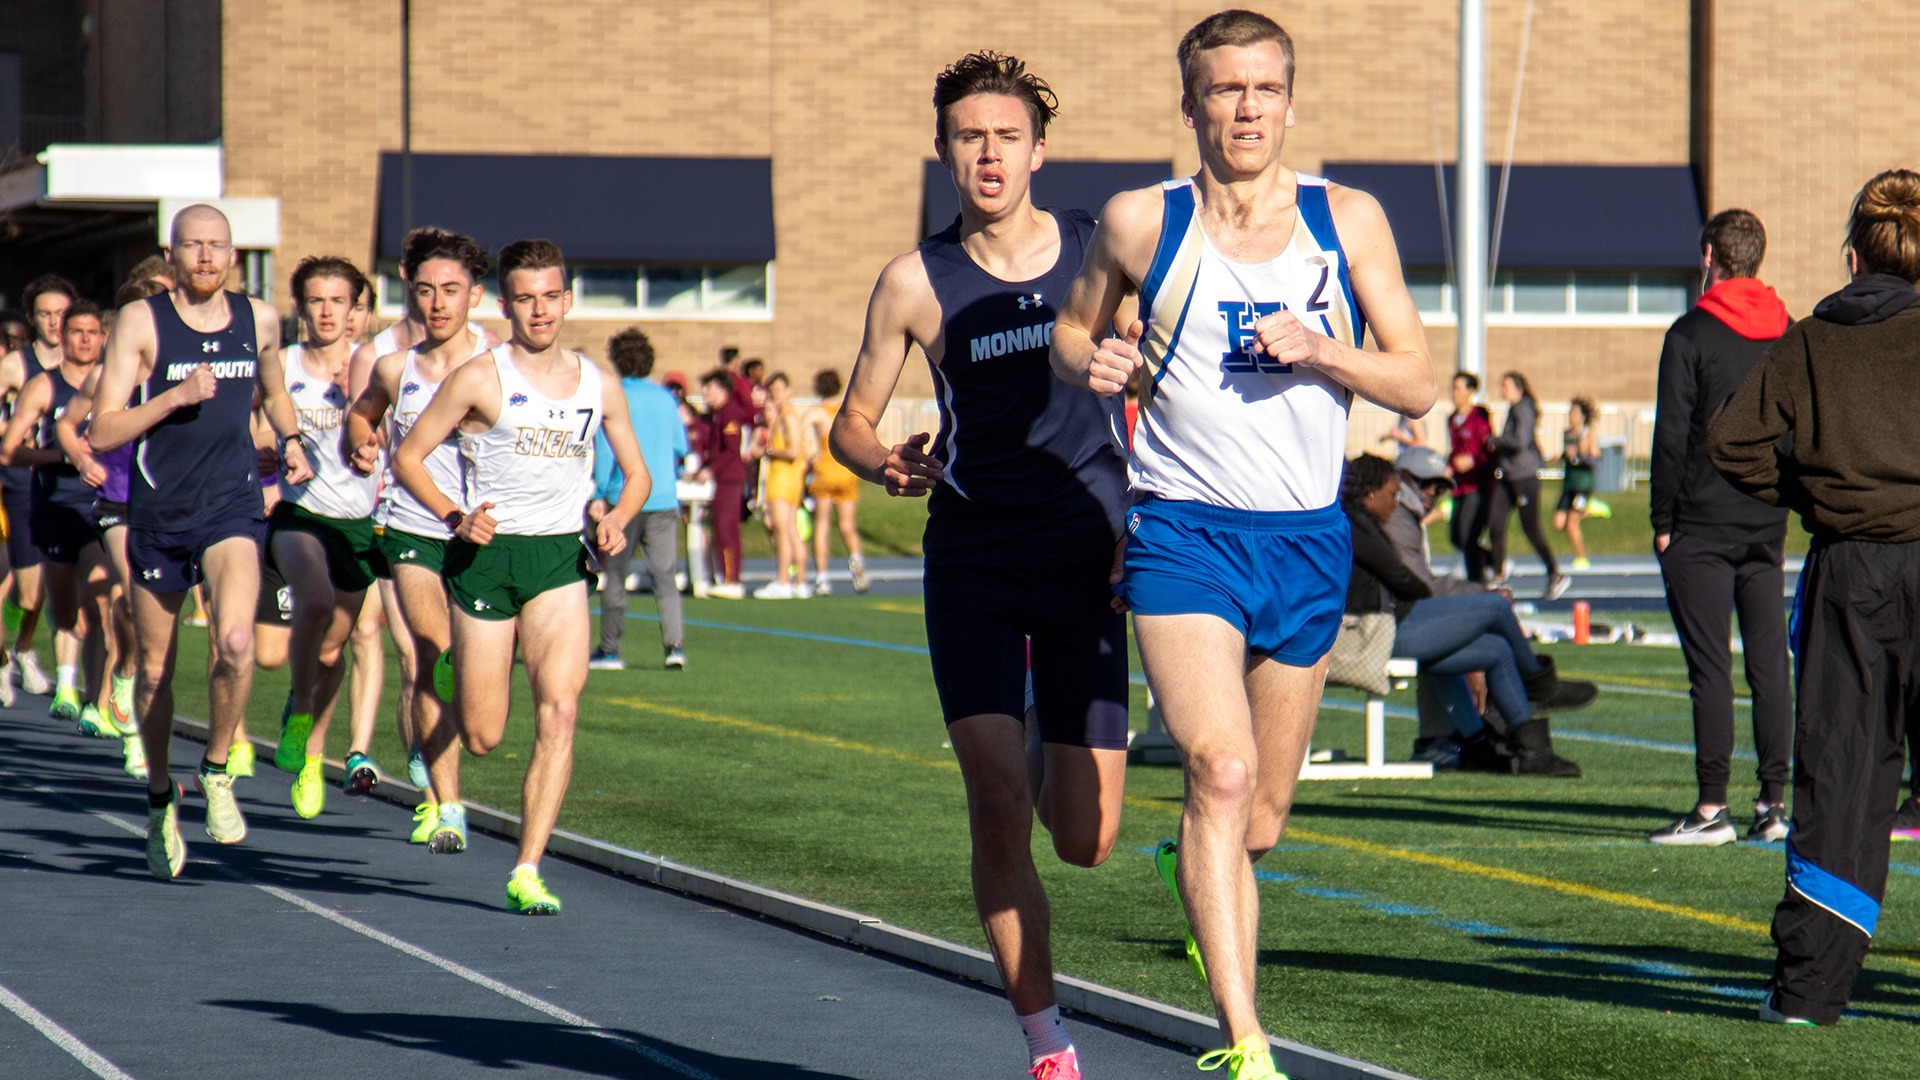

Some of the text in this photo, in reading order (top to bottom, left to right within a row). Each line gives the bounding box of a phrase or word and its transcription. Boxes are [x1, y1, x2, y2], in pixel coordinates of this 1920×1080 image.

[1304, 255, 1329, 312] 2
[970, 321, 1055, 363] MONMO
[166, 360, 256, 381] MOOUTH
[576, 408, 594, 442] 7
